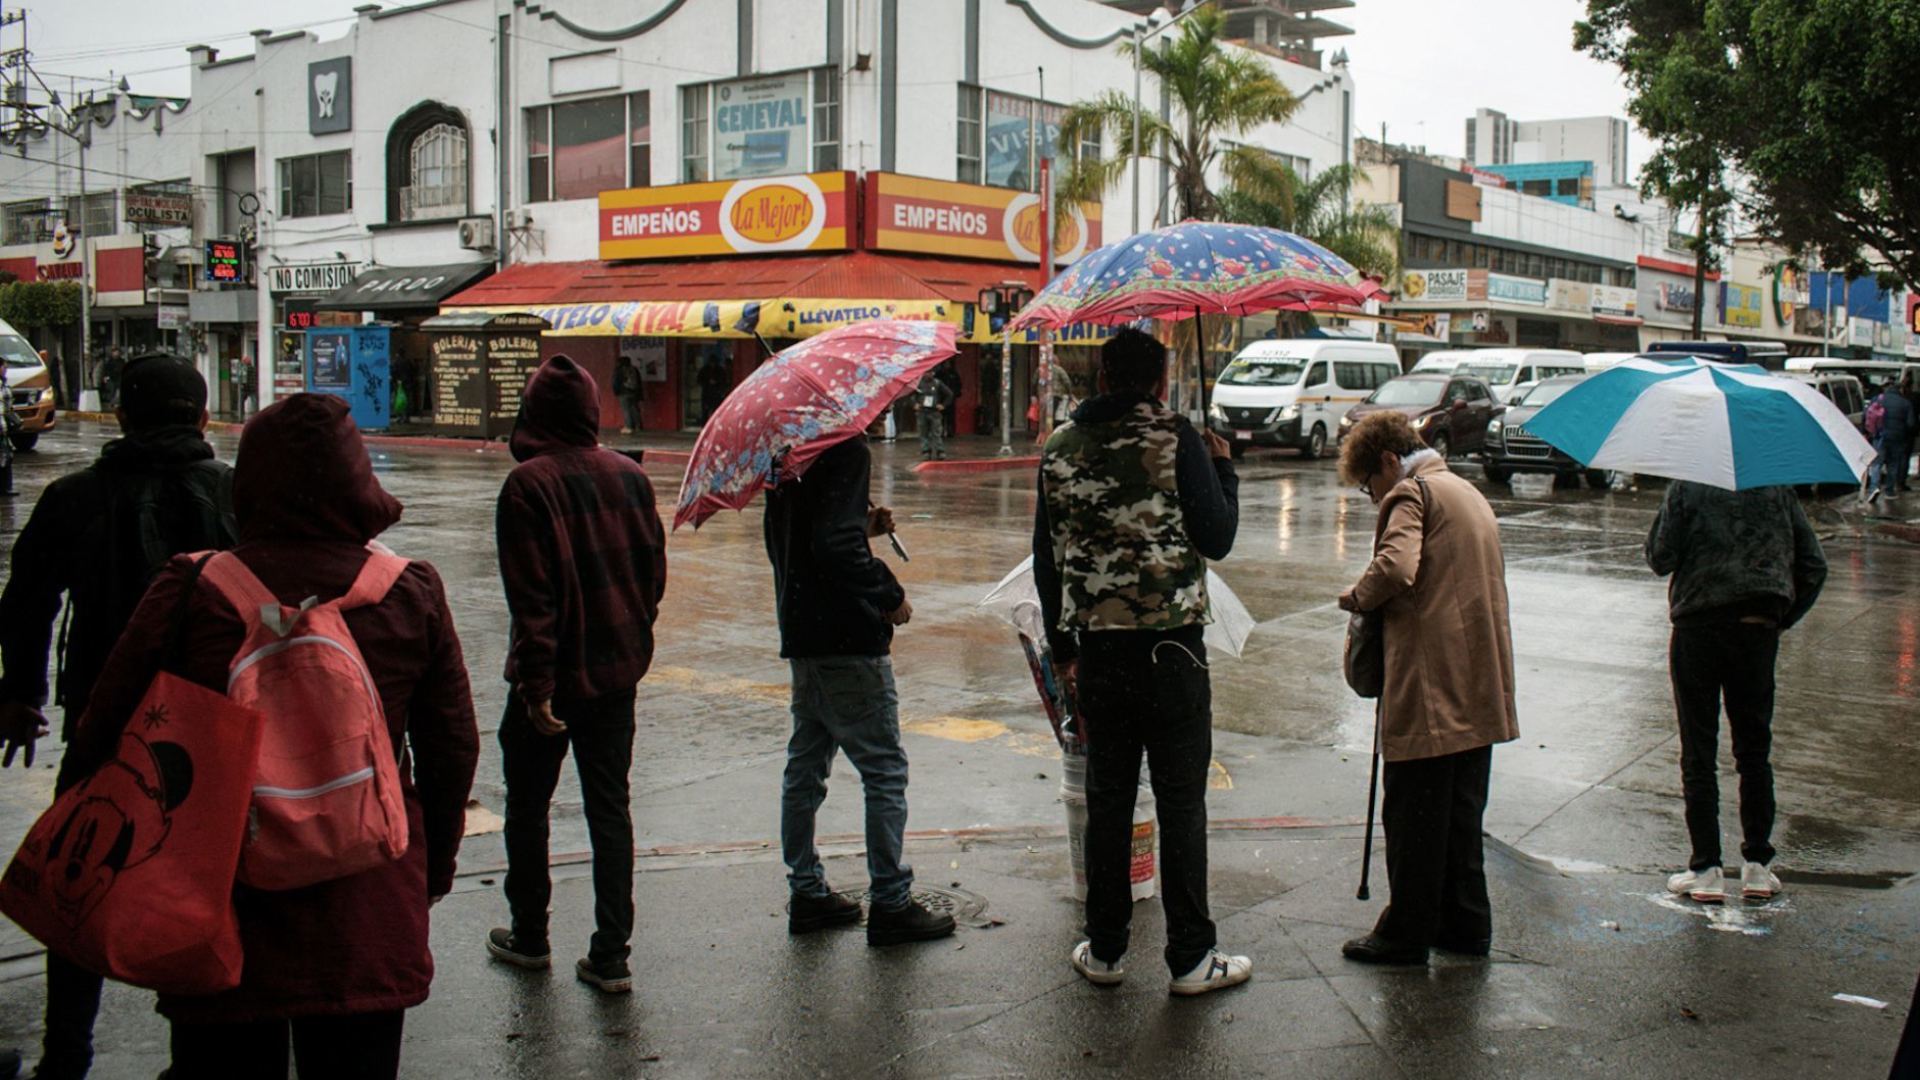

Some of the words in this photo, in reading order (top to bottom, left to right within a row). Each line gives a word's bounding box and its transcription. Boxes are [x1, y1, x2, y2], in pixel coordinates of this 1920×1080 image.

[717, 97, 807, 133] CENEVAL
[991, 124, 1060, 153] VISA
[128, 207, 188, 221] OCULISTA
[611, 207, 701, 236] EMPEÑOS
[735, 199, 754, 230] La
[758, 192, 810, 238] Mejor!
[893, 203, 988, 236] EMPEÑOS
[274, 268, 292, 289] NO
[295, 265, 356, 289] COMISION
[356, 276, 445, 293] PARDO
[1427, 271, 1465, 287] PASAJE
[433, 335, 478, 355] BOLERIA
[488, 337, 538, 352] BOLERIA
